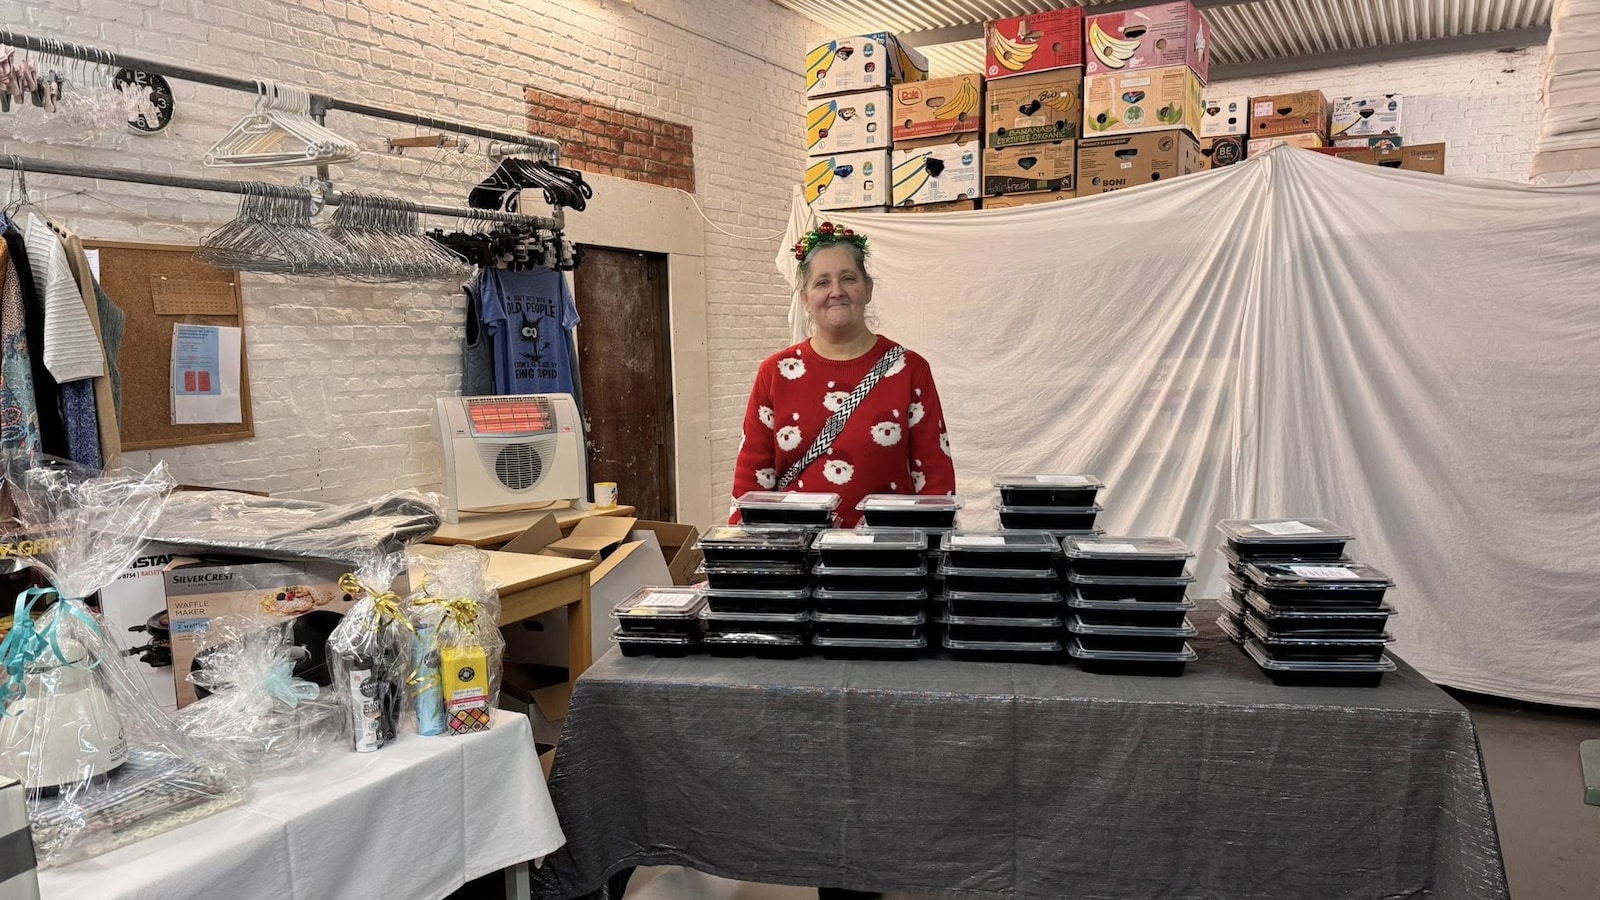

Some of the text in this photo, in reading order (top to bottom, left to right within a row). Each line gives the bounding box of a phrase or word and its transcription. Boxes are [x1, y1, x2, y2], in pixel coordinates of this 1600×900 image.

[134, 70, 147, 84] 12
[156, 86, 162, 95] 2
[901, 89, 920, 101] Dole
[157, 97, 167, 109] 3
[137, 116, 145, 128] 6
[996, 131, 1066, 145] CERTIFIED ORGANIC
[1219, 146, 1232, 155] BE
[987, 177, 1030, 194] fairfresh
[1102, 178, 1126, 187] BONI
[507, 302, 556, 317] OLD PEOPLE
[174, 600, 210, 610] WAFFLE
[175, 608, 206, 617] MAKER
